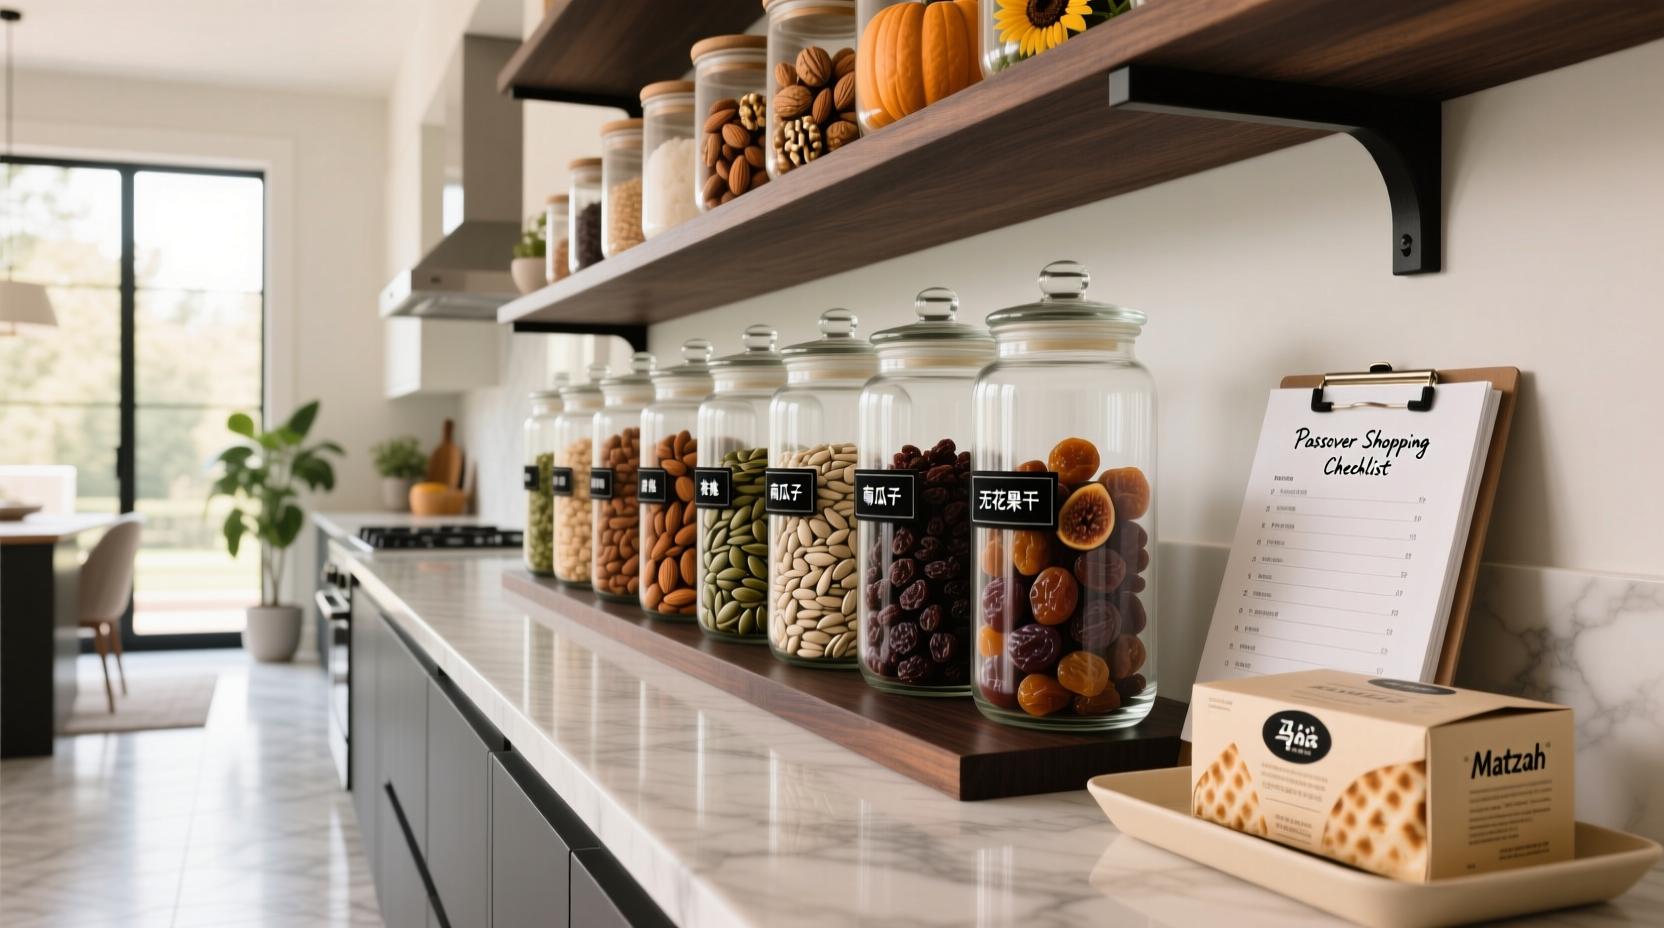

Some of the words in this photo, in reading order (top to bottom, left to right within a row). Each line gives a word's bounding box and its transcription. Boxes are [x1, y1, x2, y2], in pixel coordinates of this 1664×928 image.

[1294, 427, 1358, 449] Passover
[1361, 429, 1430, 459] Shopping
[979, 489, 1040, 513] 无花果干
[1471, 742, 1546, 780] Matzah
